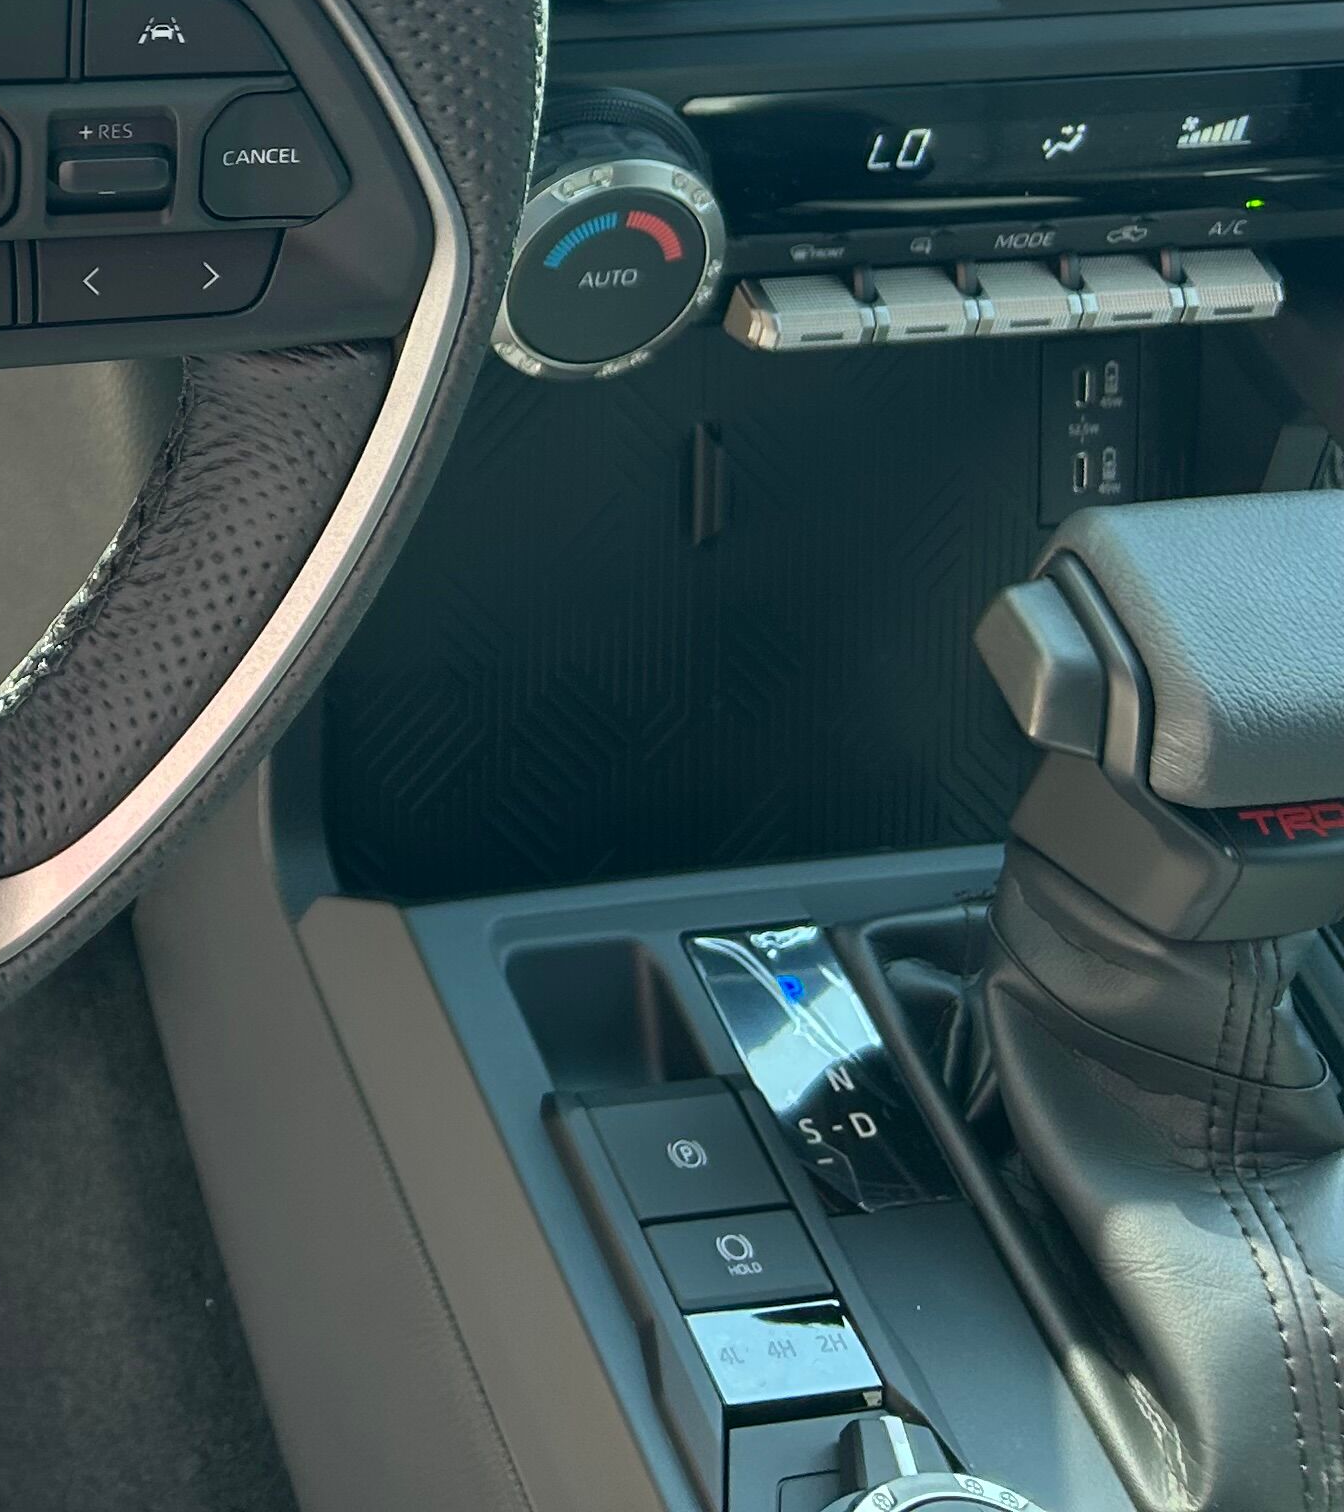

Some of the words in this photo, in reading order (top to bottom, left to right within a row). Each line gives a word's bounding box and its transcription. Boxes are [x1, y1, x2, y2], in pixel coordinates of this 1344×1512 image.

[222, 147, 301, 167] CANCEL
[866, 127, 933, 174] LO
[1209, 219, 1250, 236] A/C
[994, 231, 1056, 250] MODE
[577, 267, 639, 289] AUTO
[1237, 801, 1344, 841] TRD
[825, 1065, 855, 1093] N
[798, 1117, 823, 1144] S
[848, 1112, 878, 1138] D
[727, 1261, 763, 1277] HOLD
[767, 1338, 798, 1360] 4H
[815, 1332, 849, 1354] 2H
